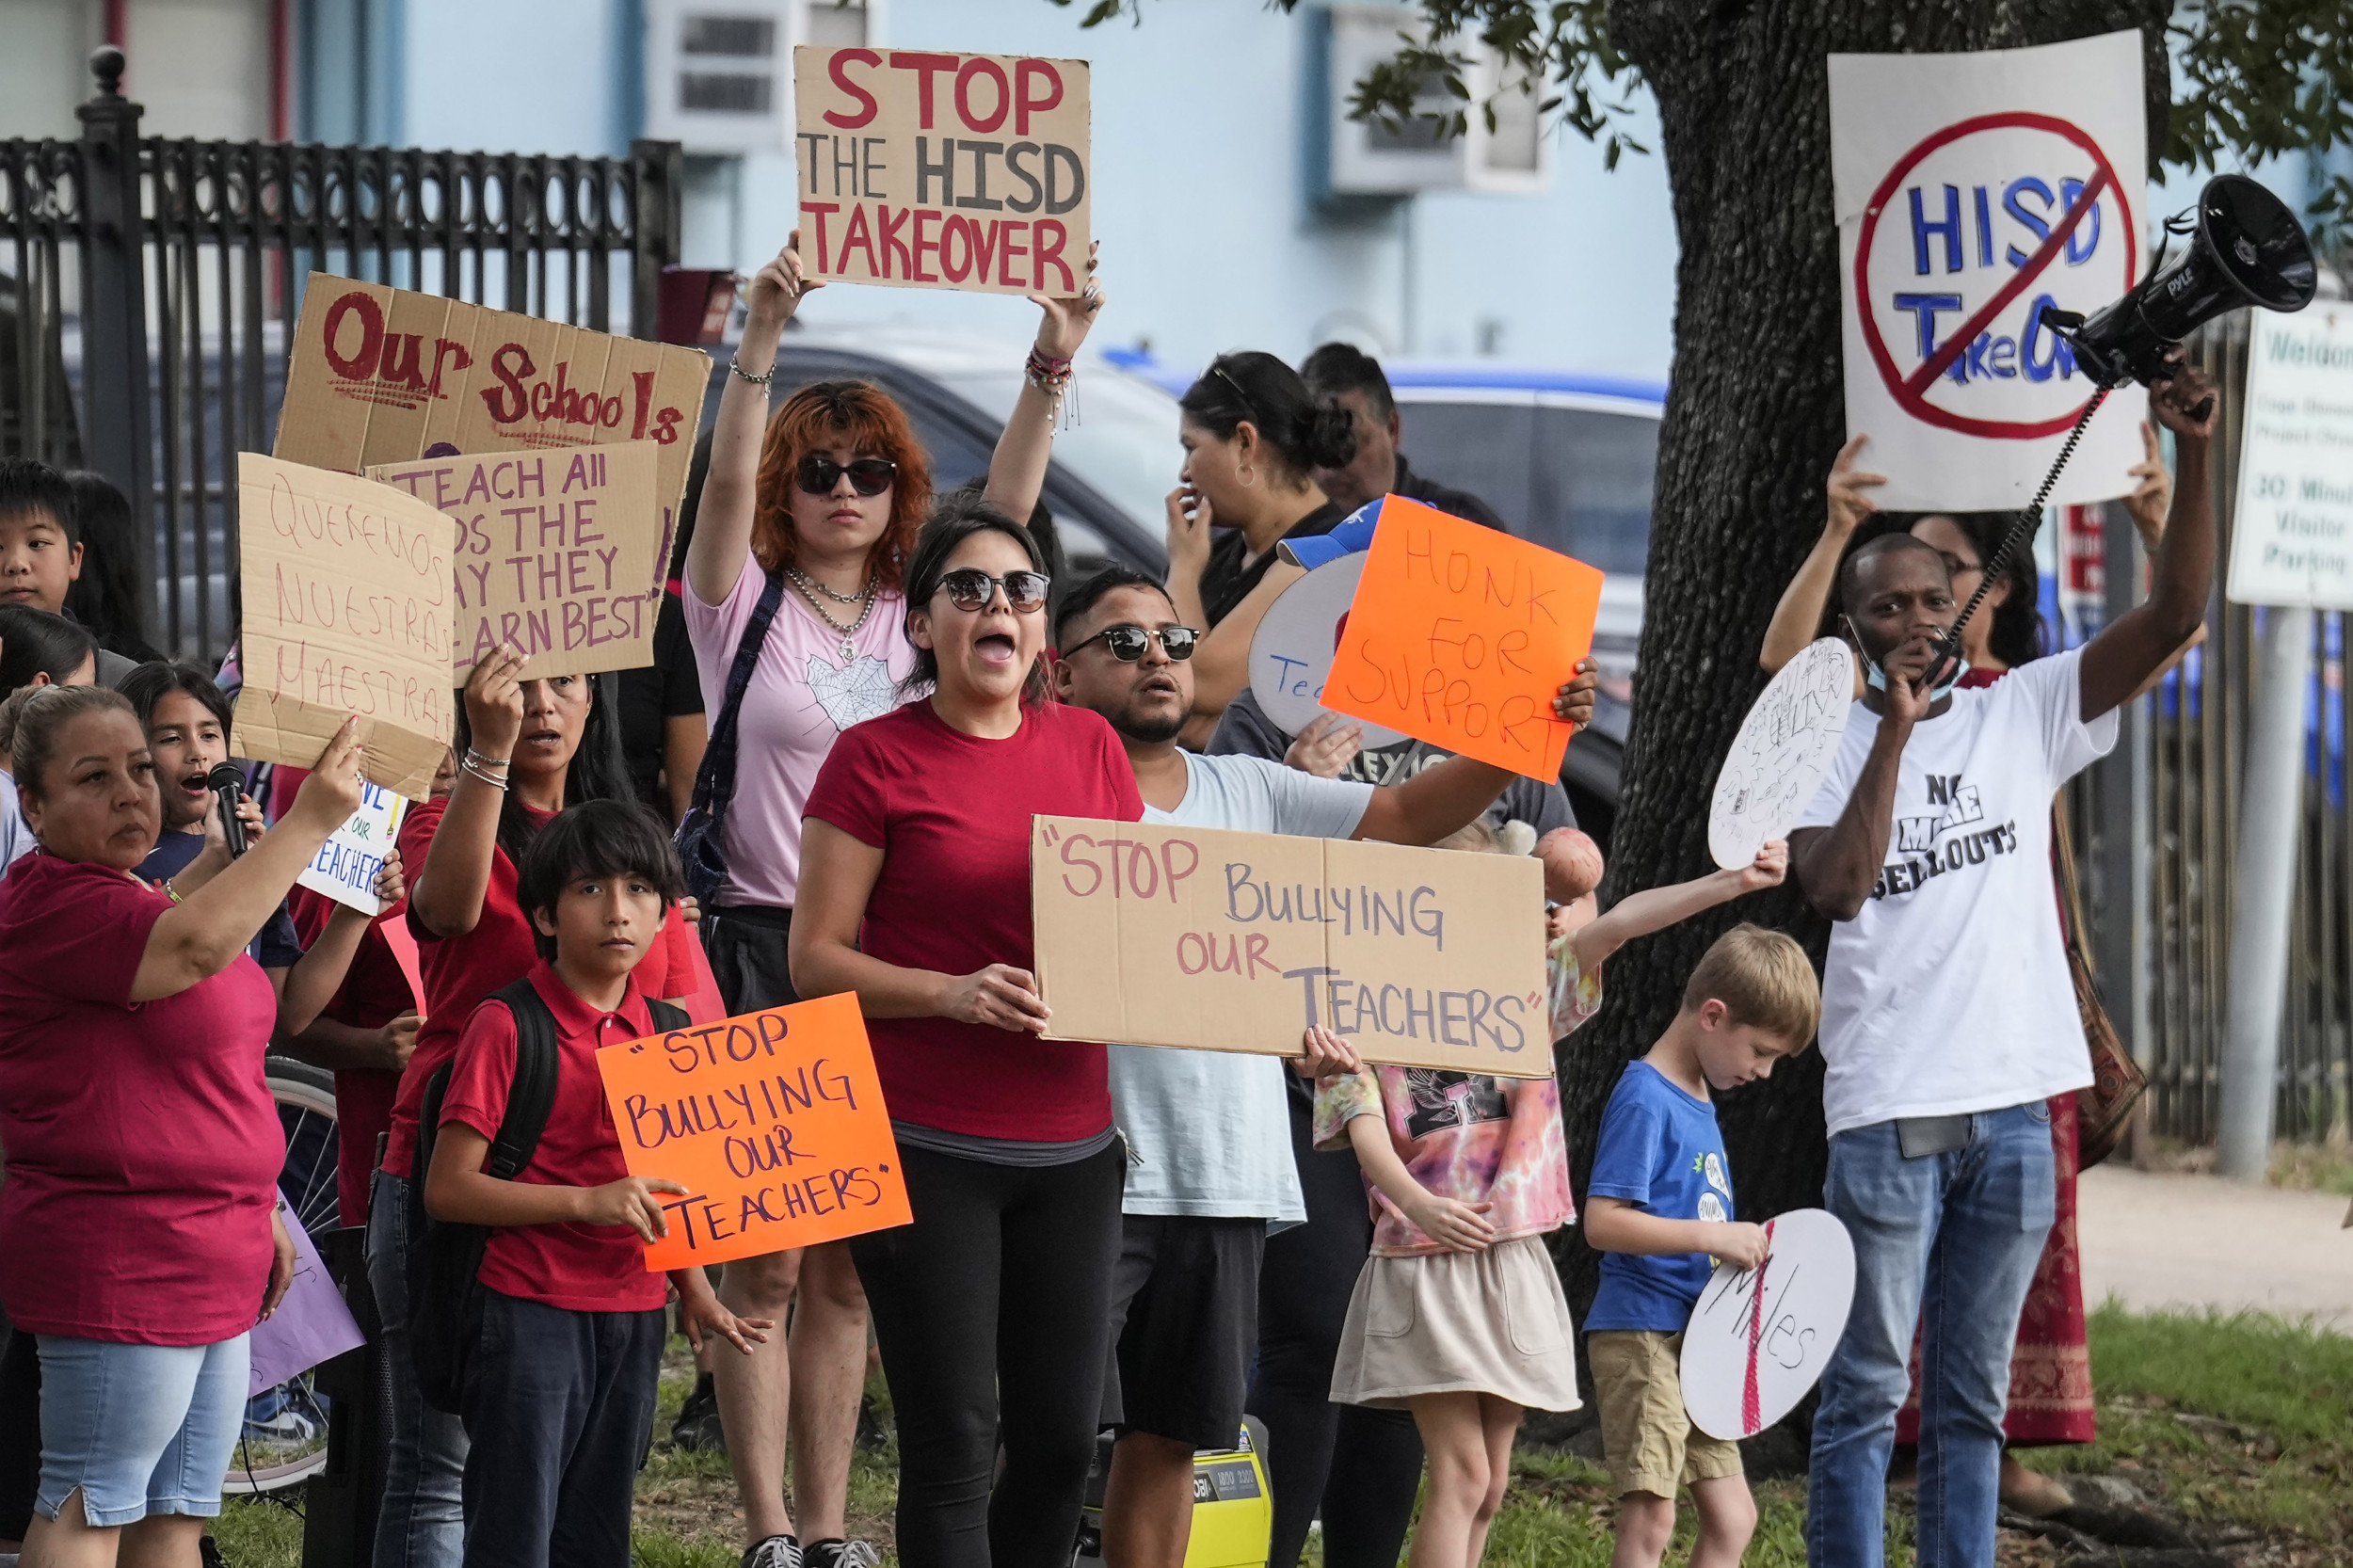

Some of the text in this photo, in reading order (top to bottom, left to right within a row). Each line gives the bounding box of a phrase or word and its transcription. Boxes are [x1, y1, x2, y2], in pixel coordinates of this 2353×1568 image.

[823, 48, 1064, 136] STOP
[797, 133, 1084, 215] THE HISD
[800, 201, 1075, 293] TAKEOVER
[1907, 176, 2101, 276] HISD
[2167, 266, 2193, 296] PYLE
[324, 292, 683, 444] Our Schools
[501, 499, 604, 552] THE
[276, 562, 450, 663] NUESTRAS
[505, 546, 618, 602] THEY
[1406, 529, 1558, 625] HONK
[1427, 617, 1532, 676] FOR
[1347, 638, 1571, 779] SUPPORT
[351, 816, 371, 840] OUR
[1176, 932, 1281, 980] OUR
[724, 1125, 817, 1178] OUR
[1705, 1253, 1816, 1369] Miles
